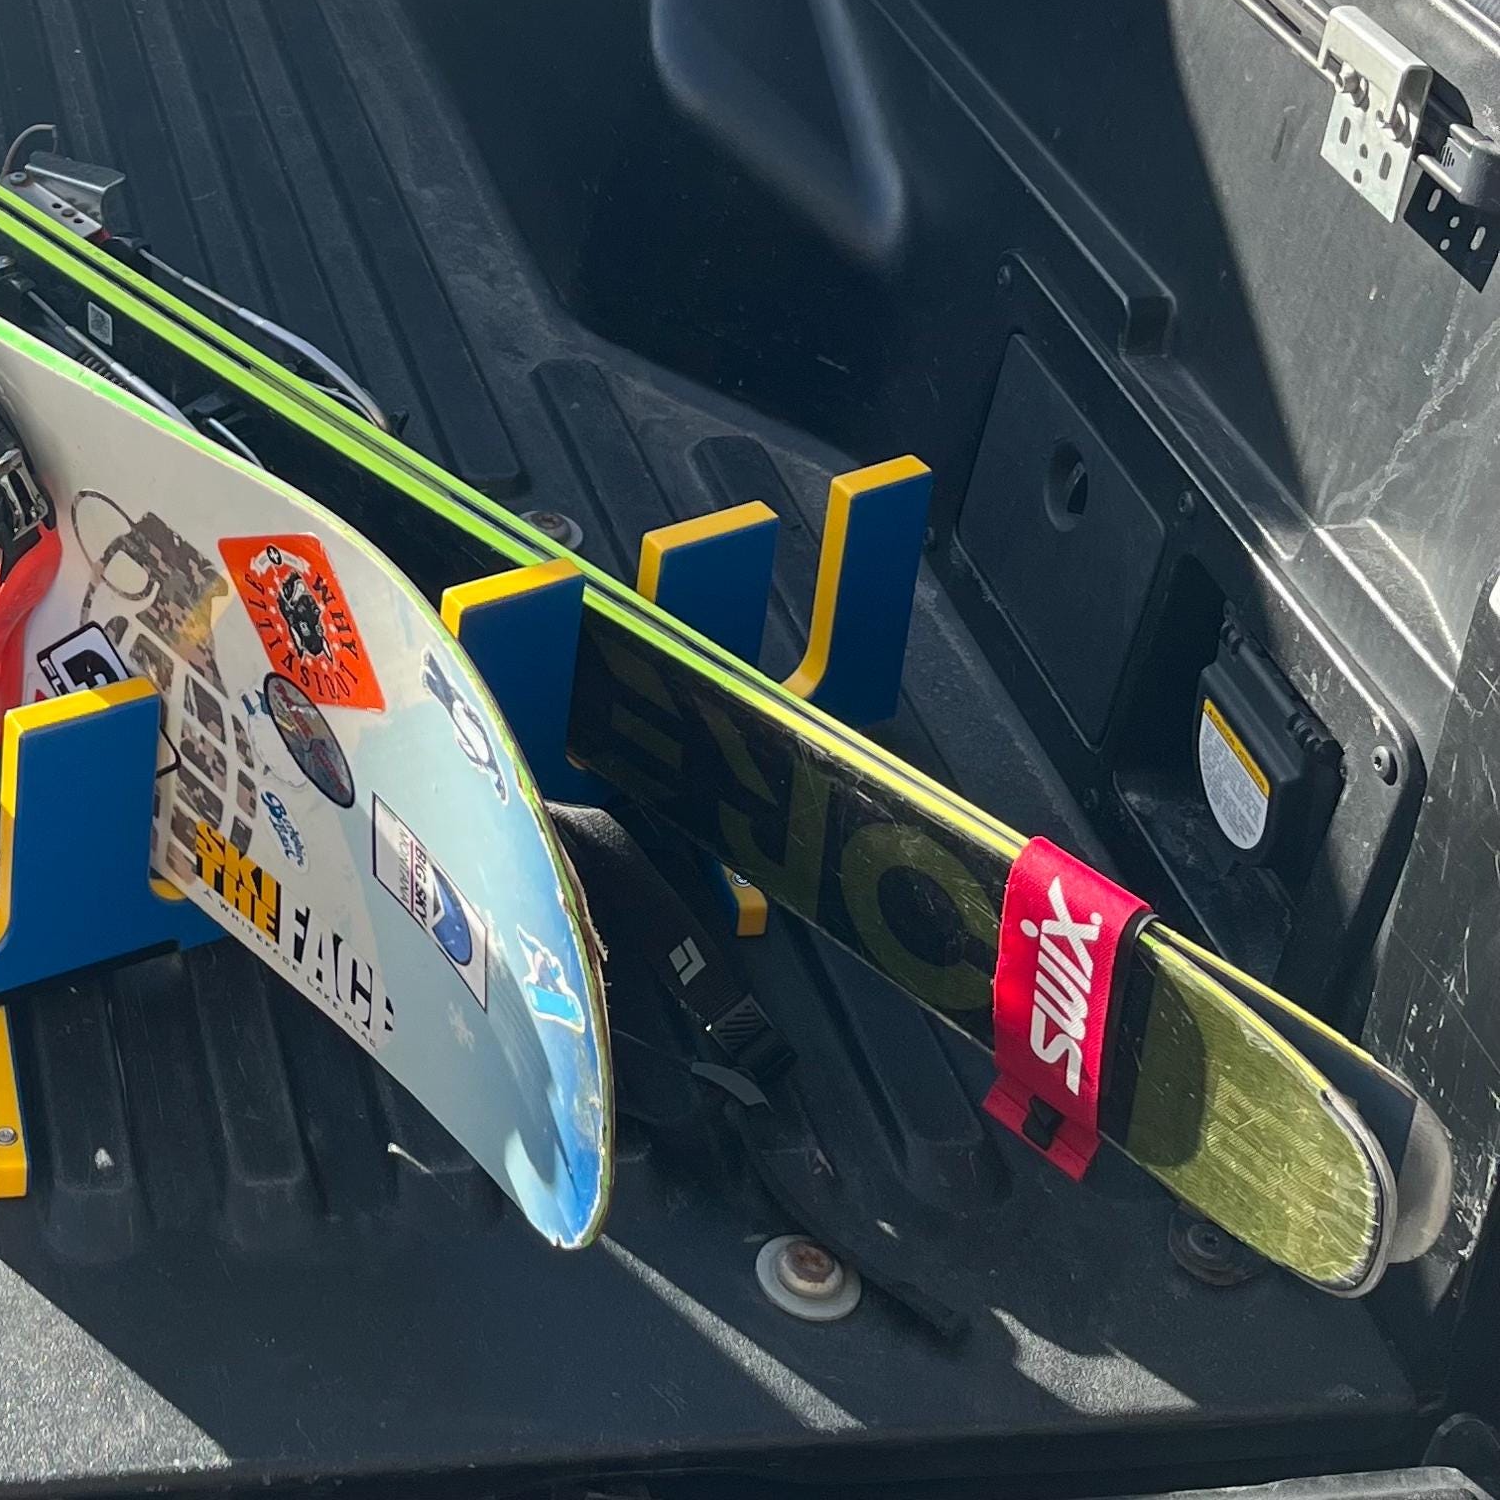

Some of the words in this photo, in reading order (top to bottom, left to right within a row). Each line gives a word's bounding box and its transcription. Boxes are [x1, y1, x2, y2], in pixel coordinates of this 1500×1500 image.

[196, 820, 280, 912] SKI
[197, 851, 280, 945] THE
[415, 845, 427, 884] BIG
[415, 882, 428, 926] SKY
